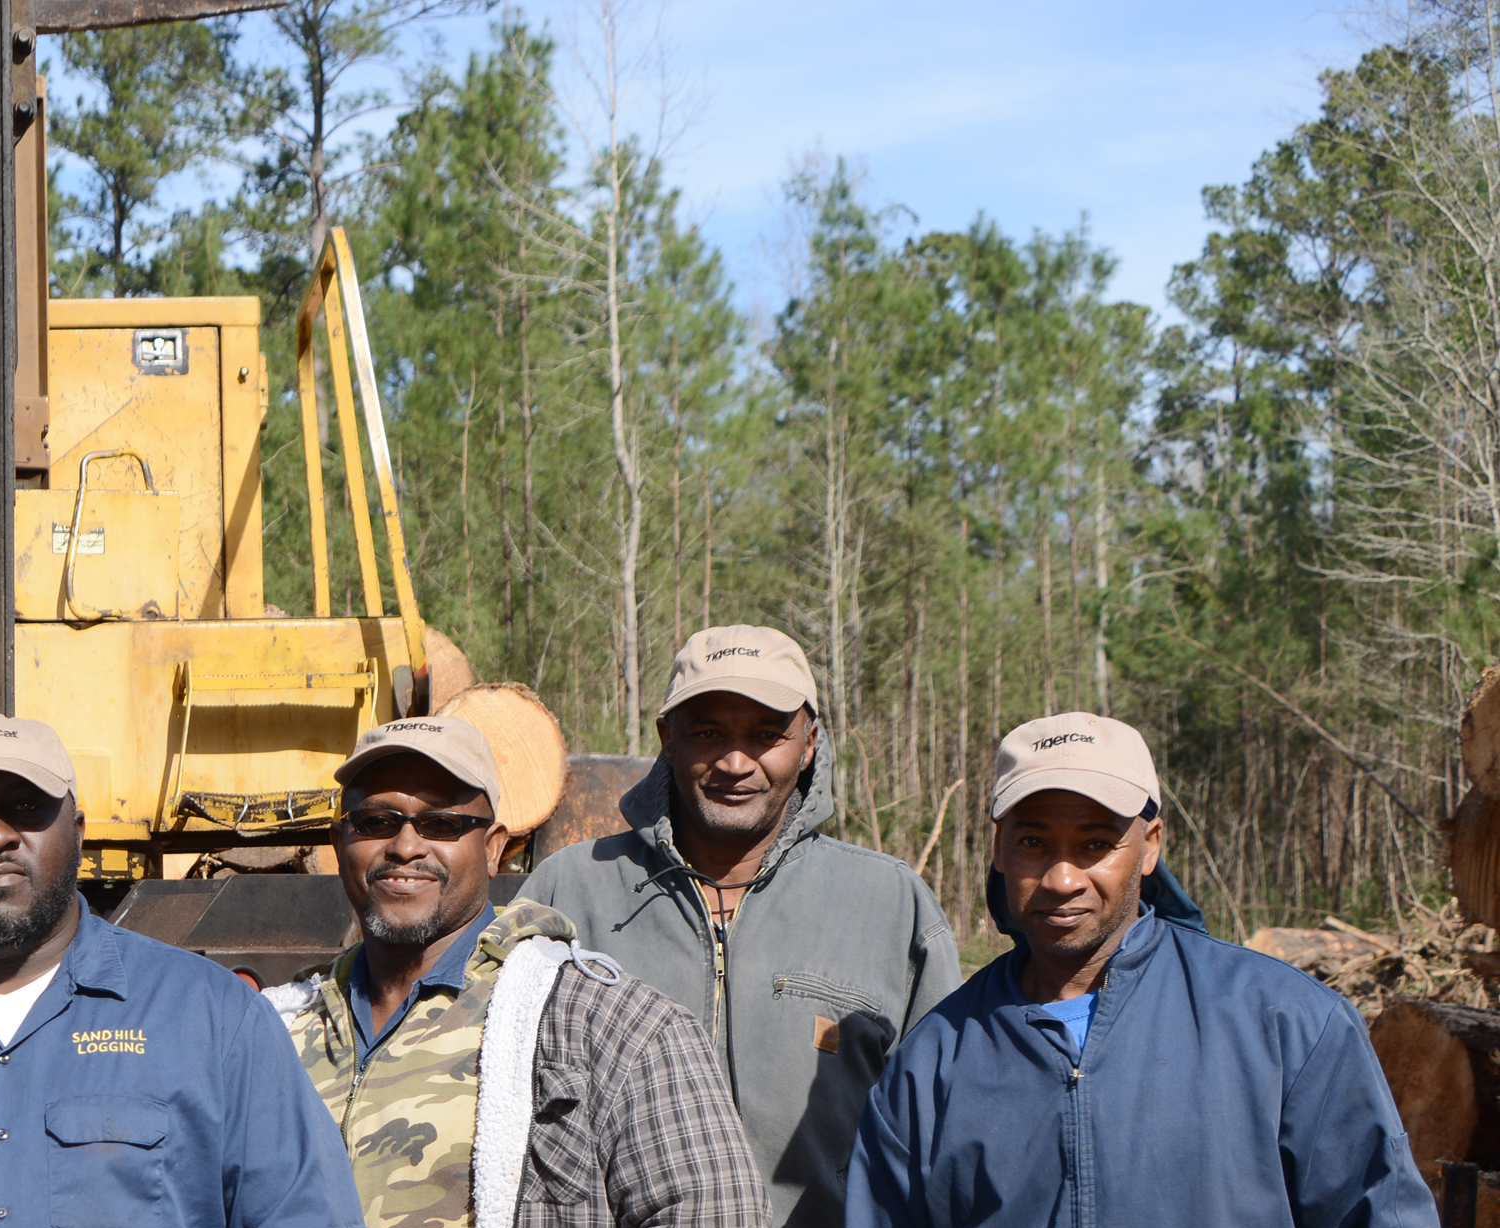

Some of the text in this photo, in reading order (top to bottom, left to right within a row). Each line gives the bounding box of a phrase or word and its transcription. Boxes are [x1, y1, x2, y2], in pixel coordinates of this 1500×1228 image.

[705, 646, 761, 663] Tigercat
[385, 722, 445, 733] Tigercat
[1032, 732, 1096, 752] Tigercat
[72, 1029, 148, 1044] SAND HILL
[77, 1041, 146, 1055] LOGGING
